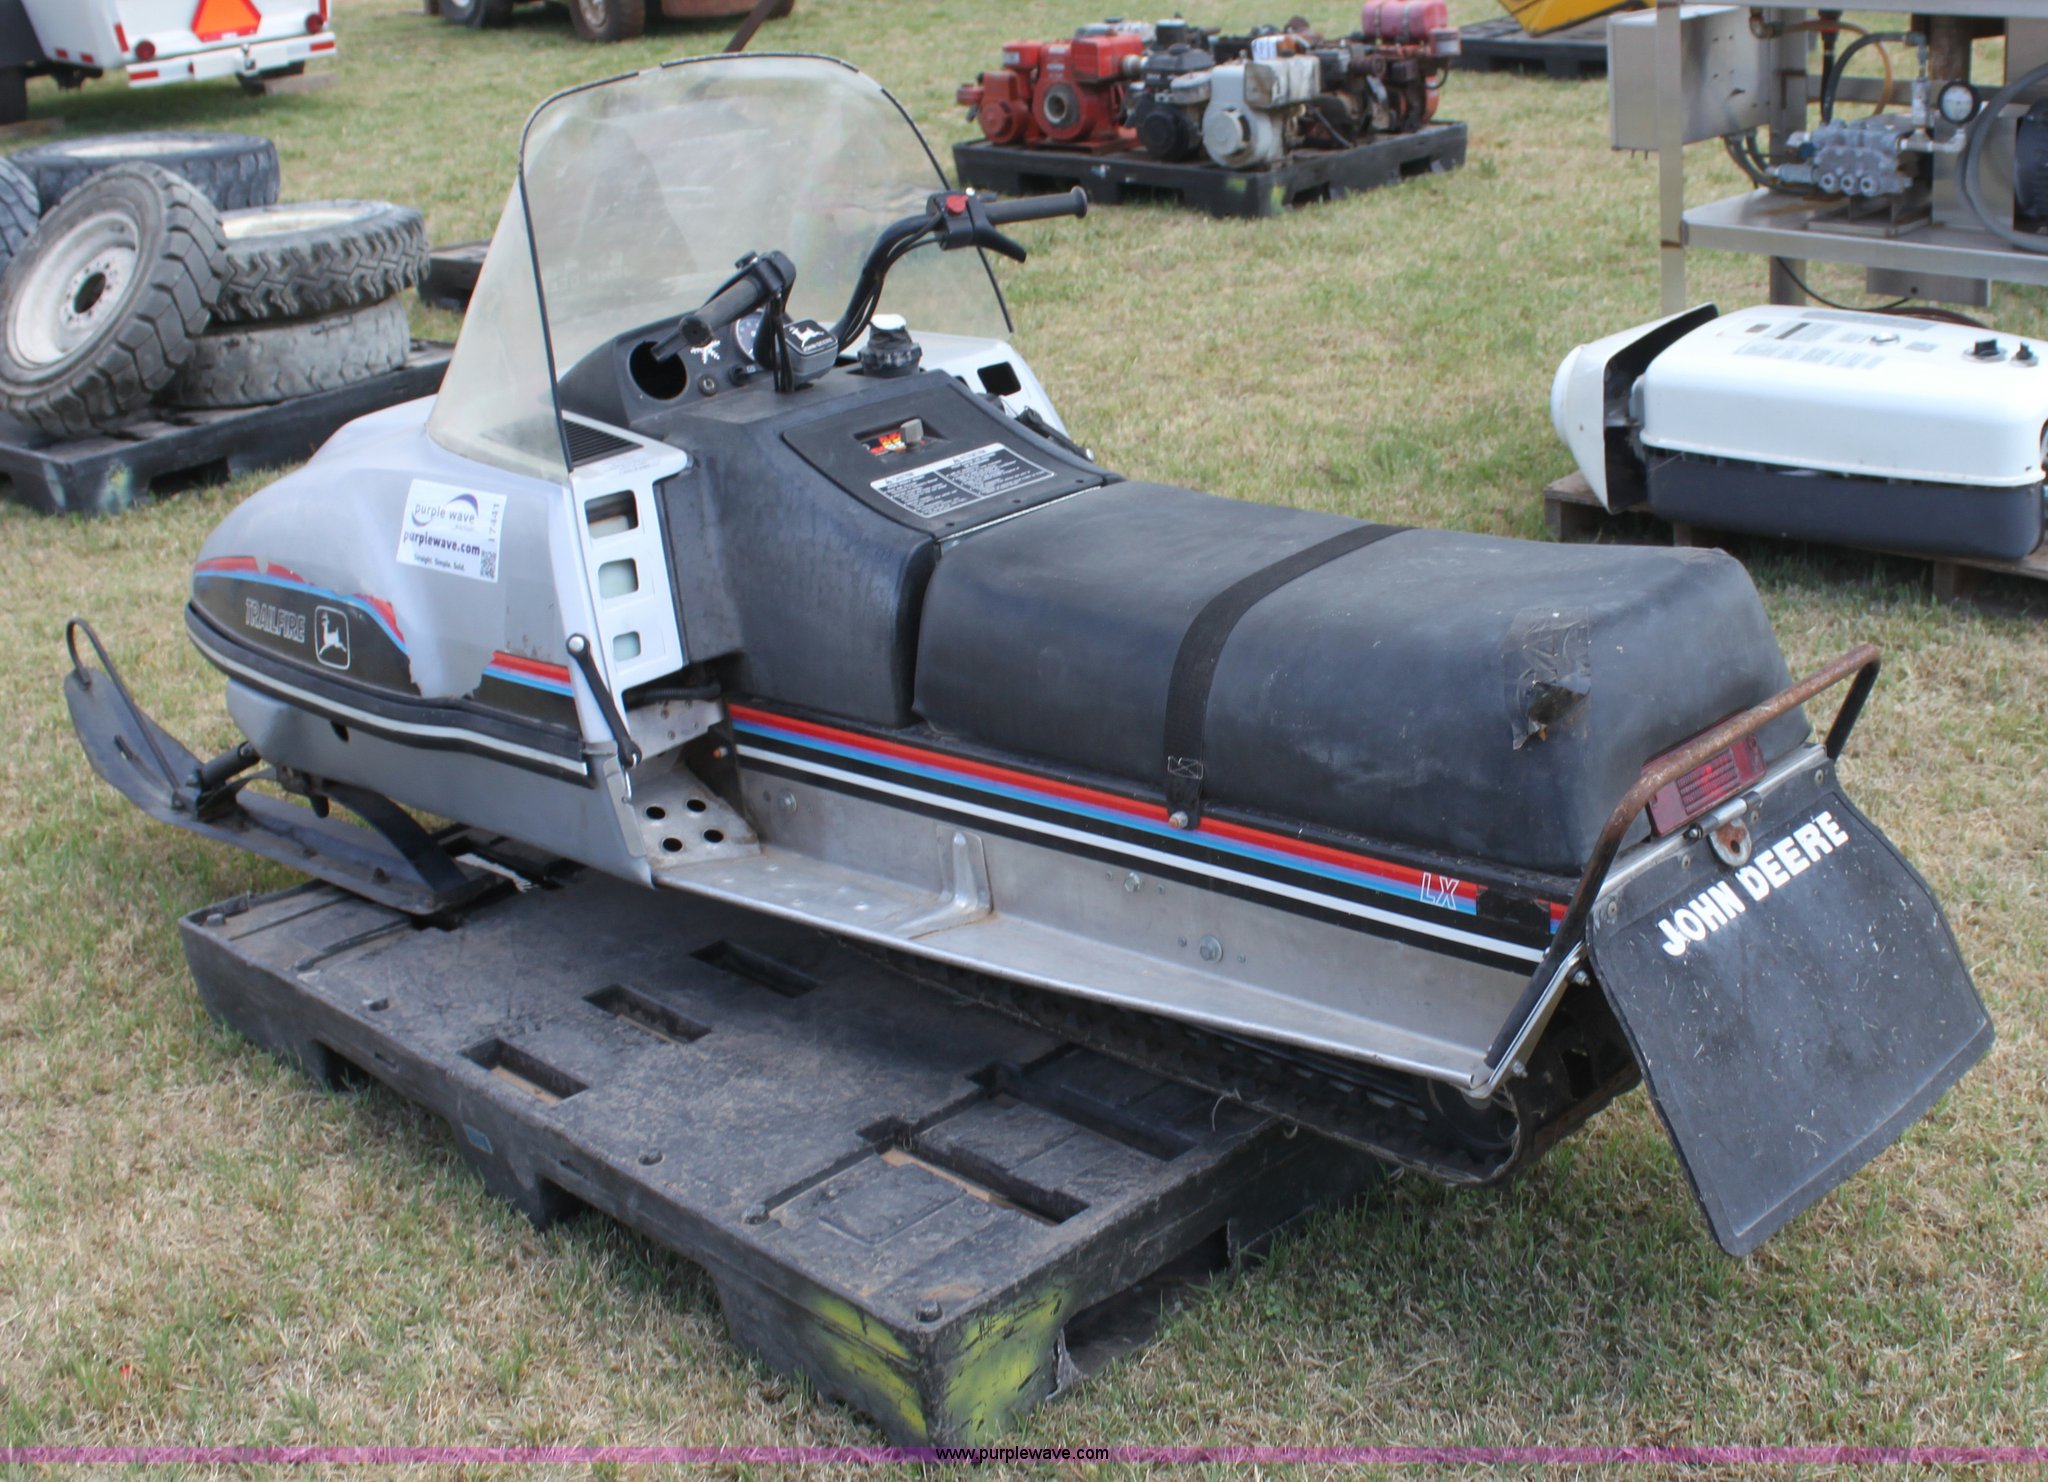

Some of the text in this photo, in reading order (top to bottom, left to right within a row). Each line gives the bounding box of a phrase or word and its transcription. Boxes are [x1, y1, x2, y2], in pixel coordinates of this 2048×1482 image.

[414, 503, 475, 524] purple wave
[403, 531, 481, 556] purplewave.com
[245, 597, 306, 644] TRAILFIRE
[1420, 871, 1460, 911] LX
[1657, 810, 1849, 957] JOHN DEERE
